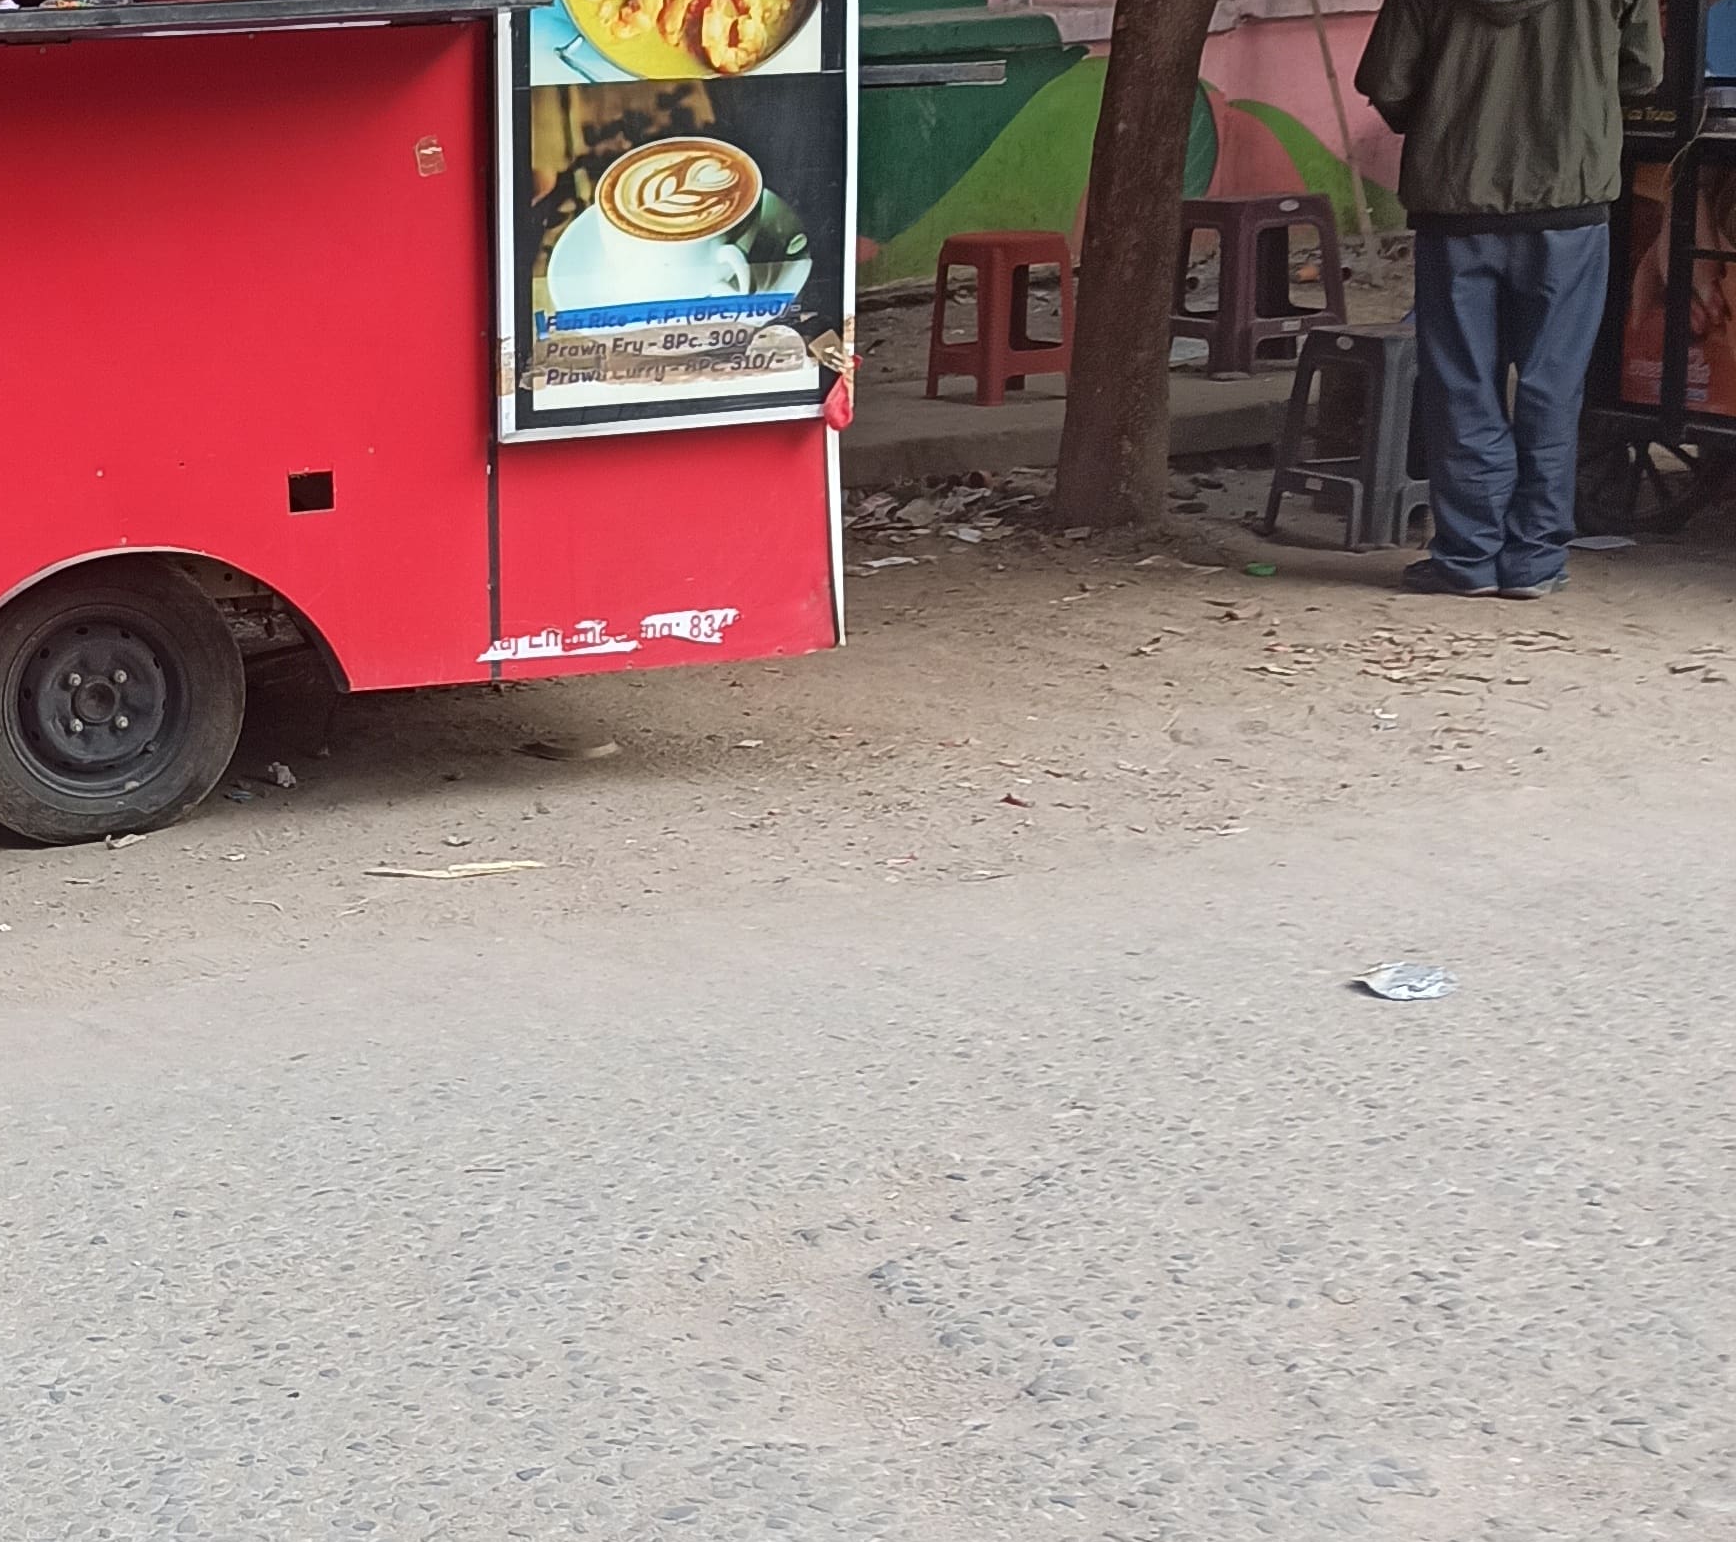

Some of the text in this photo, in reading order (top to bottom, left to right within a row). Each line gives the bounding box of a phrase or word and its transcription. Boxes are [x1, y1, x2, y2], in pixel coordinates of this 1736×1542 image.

[546, 341, 607, 358] Prawn
[612, 337, 644, 357] Fry
[662, 332, 703, 351] 8Pc.
